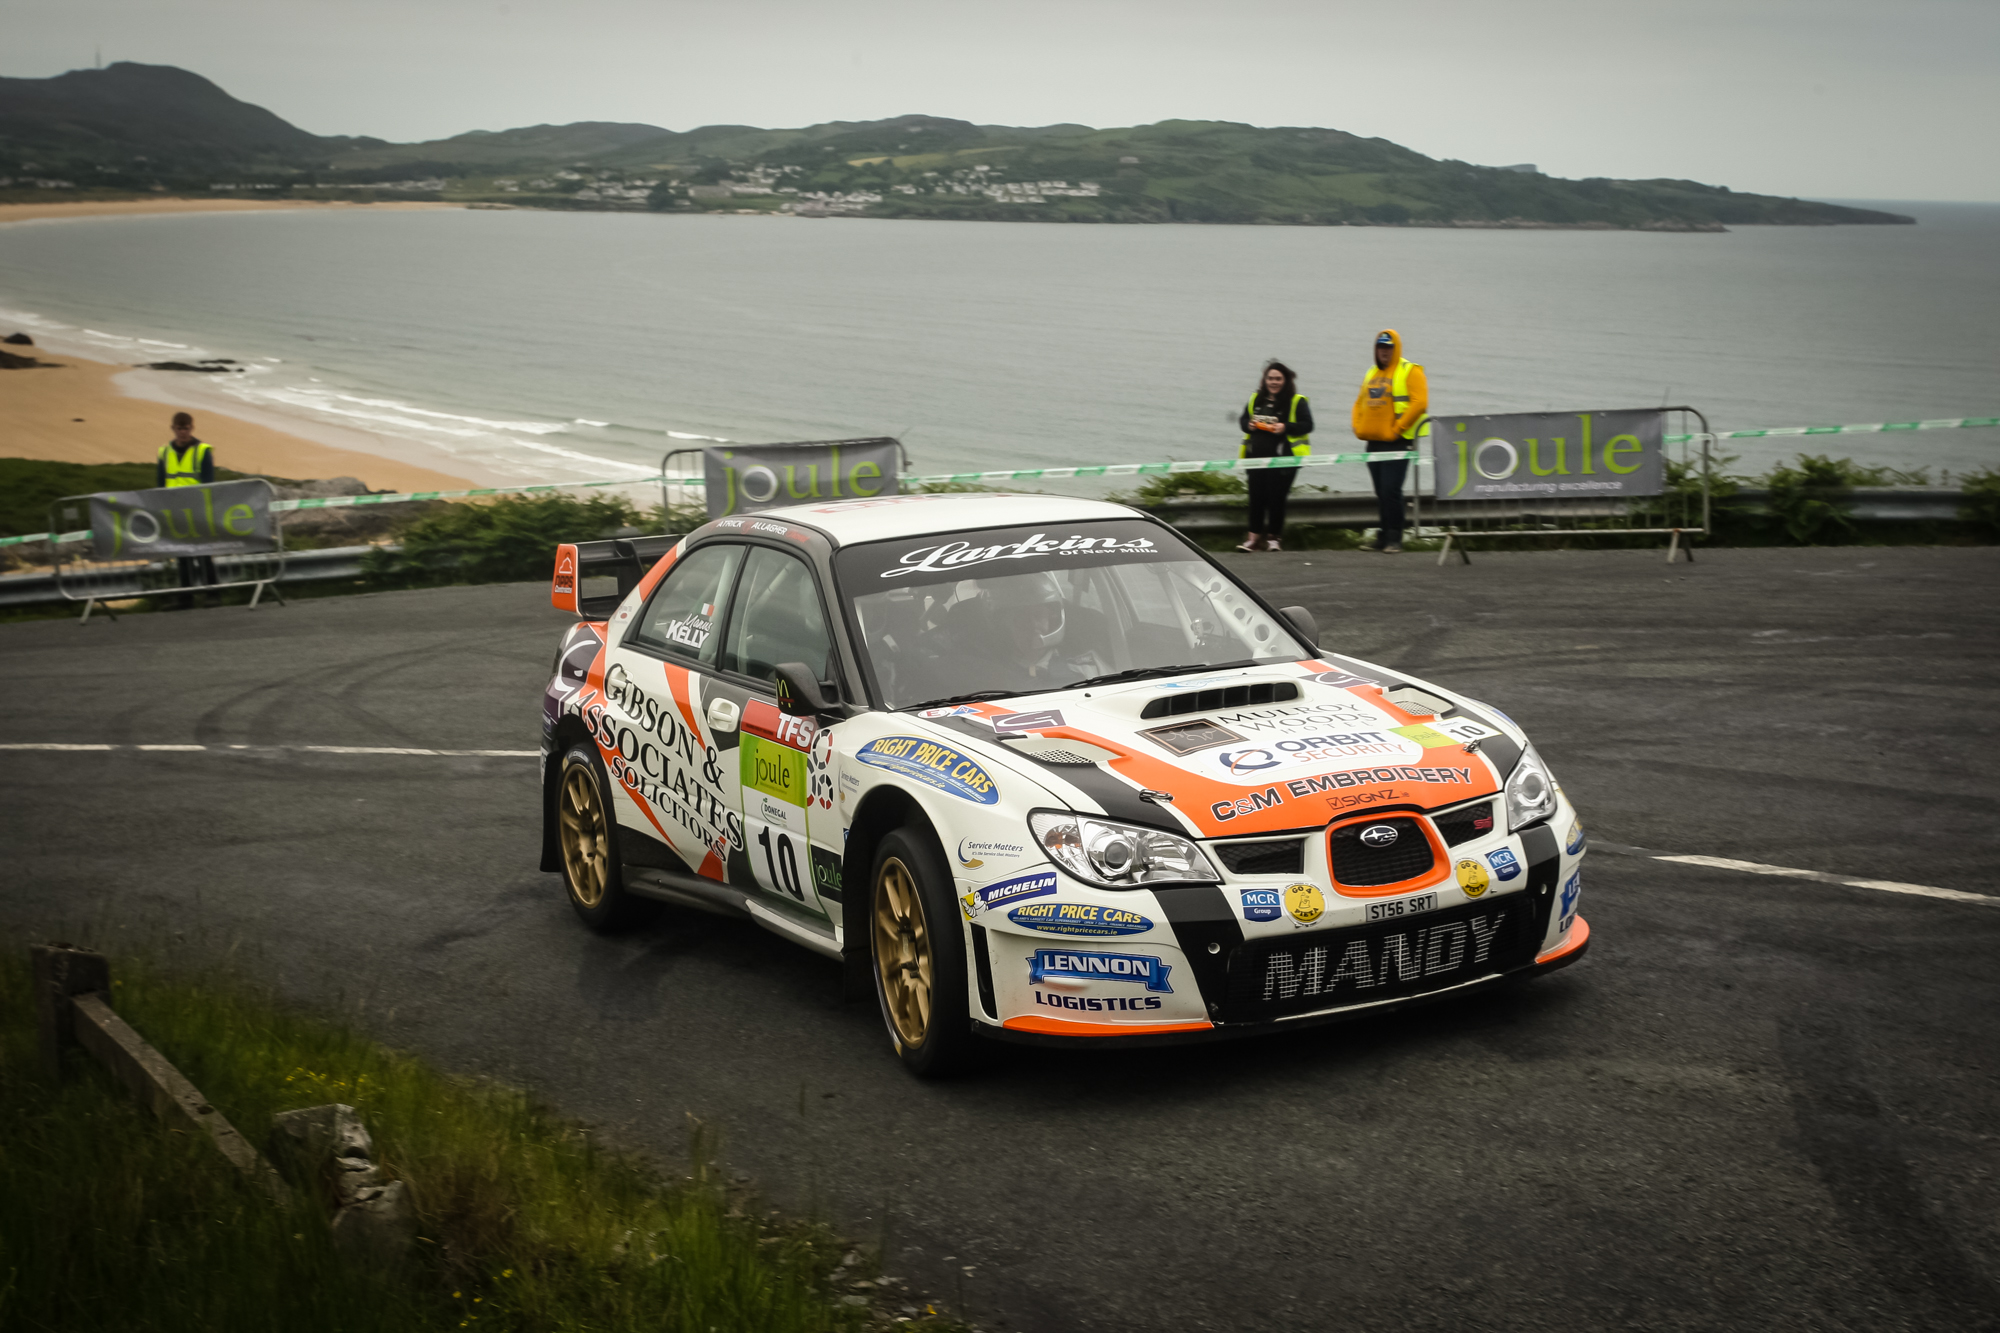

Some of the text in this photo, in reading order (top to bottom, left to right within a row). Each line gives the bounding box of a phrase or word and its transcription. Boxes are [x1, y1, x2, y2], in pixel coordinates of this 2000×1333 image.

[1448, 413, 1643, 496] joule
[721, 446, 882, 517] joule
[1474, 480, 1623, 494] manufacturing excellence
[108, 488, 255, 557] joule
[880, 533, 1154, 578] Larkins
[666, 619, 710, 648] KELLY
[682, 613, 713, 631] Manus
[1217, 703, 1361, 724] MULROY
[1239, 712, 1378, 732] WOODS
[604, 663, 726, 795] GIBSON &
[776, 712, 815, 748] TFS
[1281, 721, 1374, 735] HOTEL
[1449, 725, 1486, 739] 10
[1275, 731, 1387, 752] ORBIT
[1292, 743, 1406, 763] SECURITY
[567, 689, 744, 850] ASSOCIATES
[755, 749, 790, 788] joule
[871, 738, 917, 758] RIGHT
[909, 742, 958, 771] PRICE
[951, 761, 993, 793] CARS
[1210, 767, 1472, 822] C&M EMBROIDERY
[611, 756, 727, 862] SOLICITORS
[764, 804, 787, 821] DONEGAL
[968, 841, 1024, 852] Service Matters
[758, 825, 805, 902] 10
[1461, 862, 1471, 870] GO
[1491, 852, 1514, 867] MCR
[814, 857, 842, 888] joule
[988, 877, 1056, 901] MICHELIN
[1246, 893, 1277, 904] MCR
[1292, 886, 1304, 894] GO
[1017, 905, 1142, 924] RIGHT PRICE CARS
[1371, 895, 1433, 920] ST56 SRT
[1036, 925, 1118, 936] www.rightpricecars.ie
[1043, 954, 1151, 977] LENNON
[1262, 910, 1506, 1001] MANDY
[1035, 991, 1162, 1011] LOGISTICS
